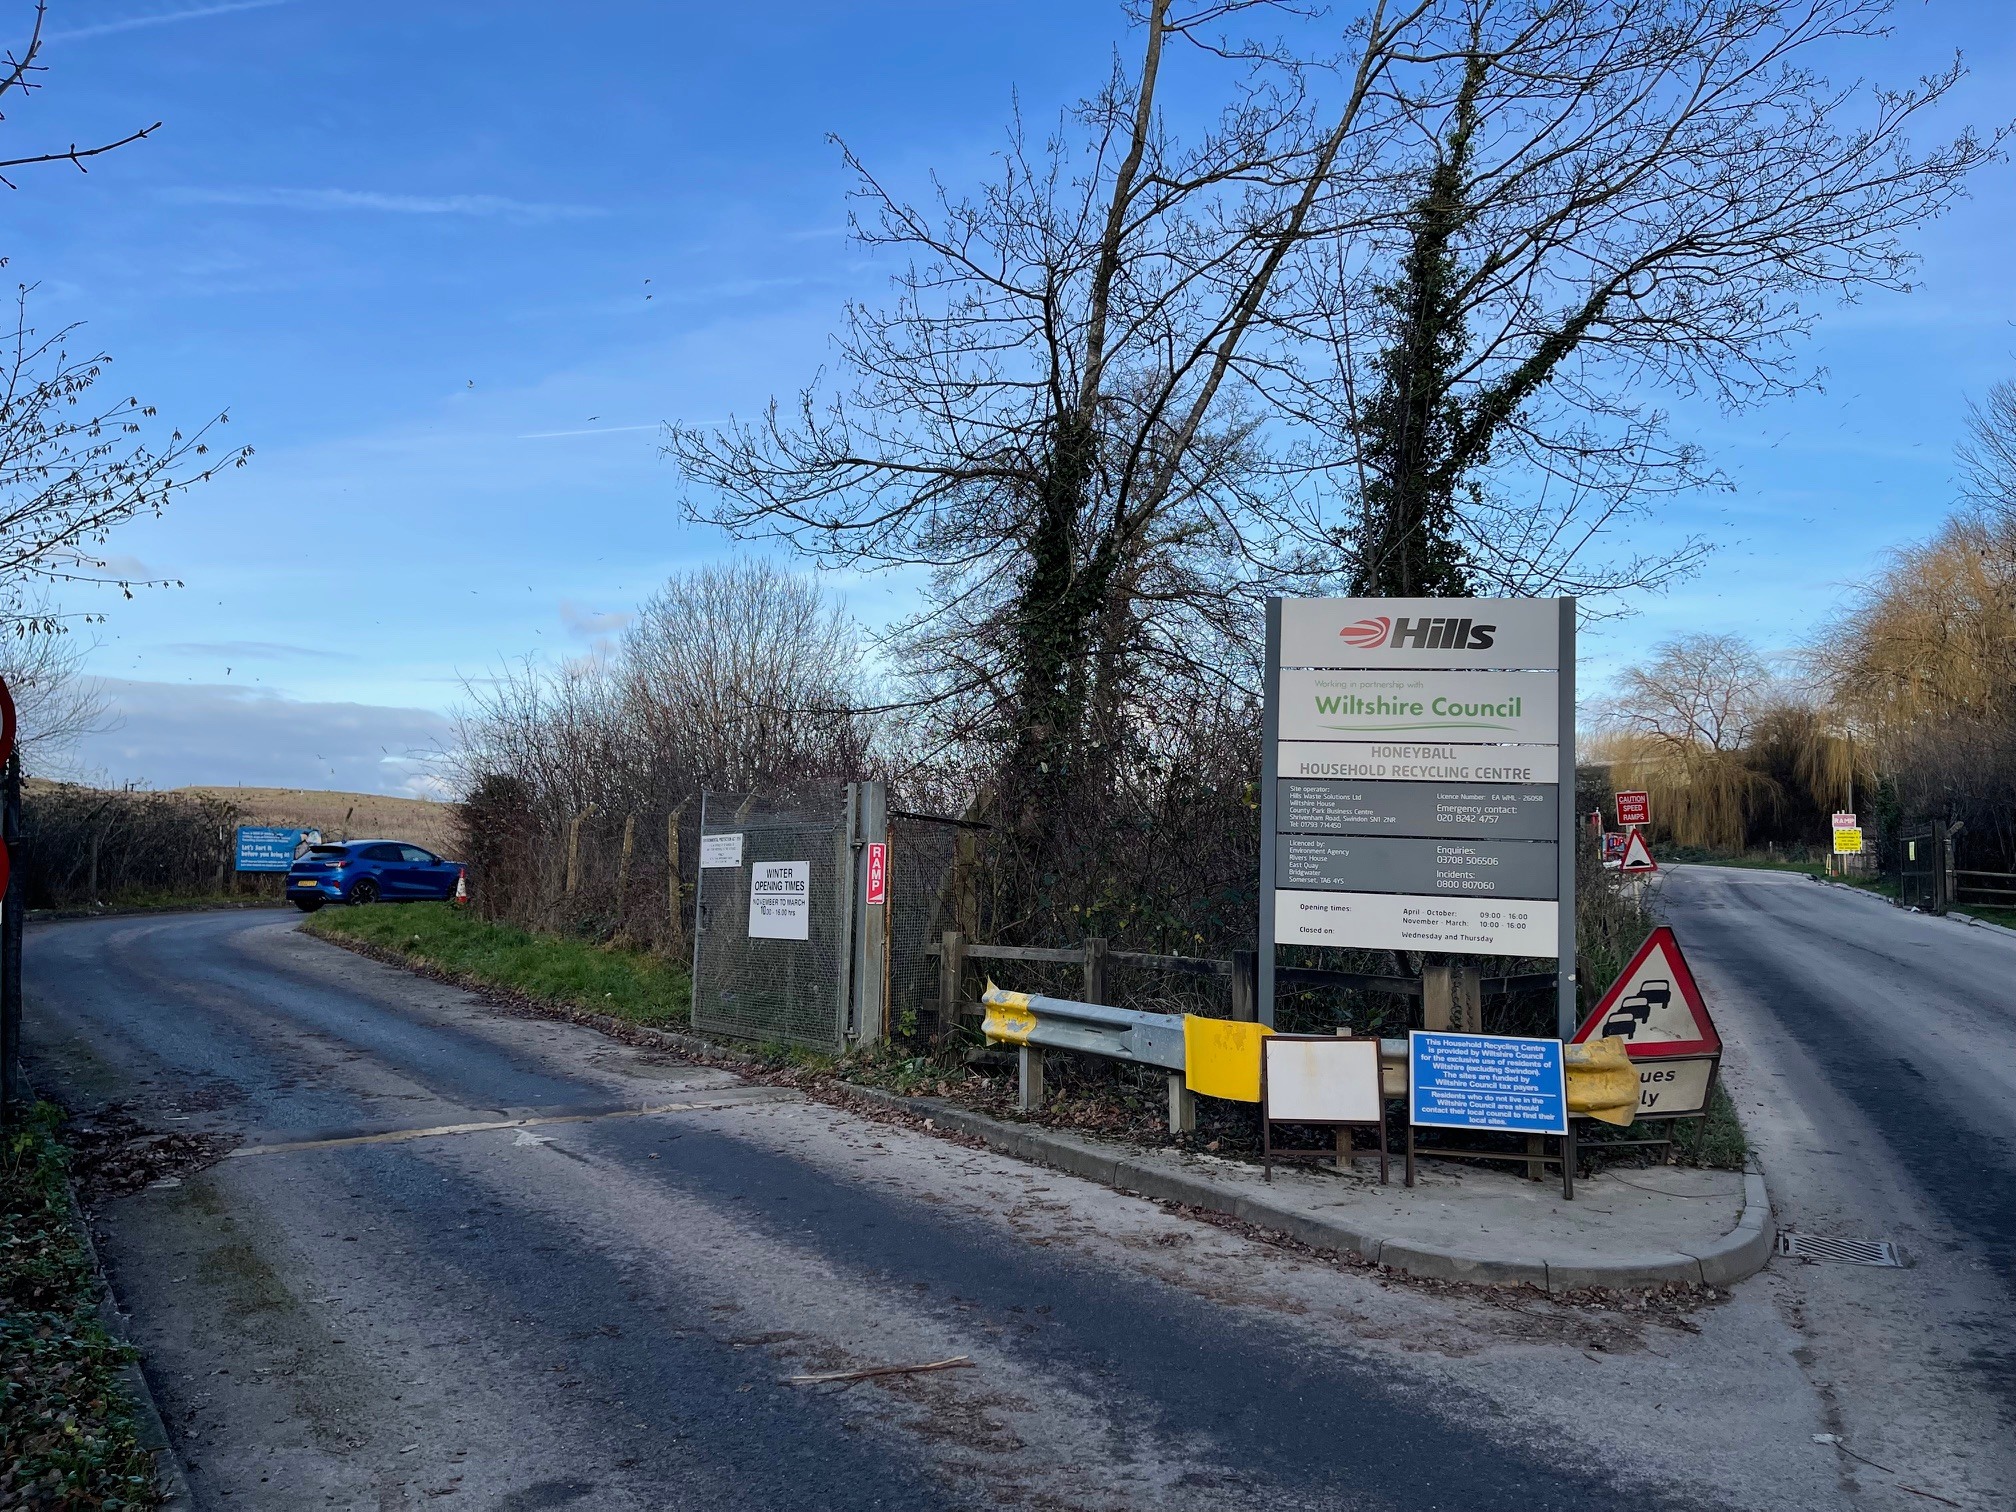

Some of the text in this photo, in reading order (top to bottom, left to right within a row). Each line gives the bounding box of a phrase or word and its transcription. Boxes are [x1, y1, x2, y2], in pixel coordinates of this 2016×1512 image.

[1390, 617, 1496, 650] Hills
[1315, 679, 1423, 689] Working in partnership with
[1315, 695, 1521, 717] Wiltshire Council
[1371, 746, 1457, 760] HONEYBALL
[1300, 763, 1530, 780] HOUSEHOLD RECYCLING CENTRE
[1290, 807, 1310, 815] County
[1437, 804, 1517, 814] Emergency contact:
[1437, 814, 1499, 823] 020 8242 4757
[1317, 840, 1325, 848] by:
[1289, 847, 1326, 855] Environment
[1437, 845, 1476, 855] Enquiries:
[1437, 856, 1499, 866] 03708 506506
[767, 869, 792, 878] WINTER
[872, 846, 881, 891] RAMP
[1437, 870, 1475, 879] Incidents:
[755, 881, 804, 891] OPENING TIMES
[1437, 880, 1495, 890] 0800 807060
[1300, 903, 1328, 912] Opening
[1403, 908, 1420, 916] April
[1299, 926, 1322, 934] Closed
[1507, 922, 1526, 930] 16:00
[1401, 932, 1442, 941] Wednesday
[1460, 934, 1494, 943] Thursday
[1443, 1040, 1481, 1049] Household
[1483, 1042, 1519, 1051] Recycling
[1521, 1044, 1546, 1052] Centre
[1436, 1048, 1468, 1056] provided
[1470, 1049, 1480, 1057] by
[1481, 1050, 1514, 1059] Wiltshire
[1446, 1056, 1480, 1064] exclusive
[1497, 1058, 1506, 1066] of
[1506, 1060, 1541, 1069] residents
[1543, 1061, 1552, 1069] of
[1432, 1062, 1540, 1077] Wiltshire (excluding Swindon).
[1443, 1071, 1457, 1079] The
[1458, 1072, 1476, 1080] sites
[1492, 1074, 1518, 1083] funded
[1520, 1075, 1530, 1084] by
[1640, 1070, 1675, 1083] ues
[1435, 1079, 1467, 1087] Wiltshire
[1469, 1081, 1497, 1089] Council
[1513, 1084, 1539, 1092] payers
[1431, 1091, 1465, 1100] Residents
[1467, 1093, 1482, 1101] who
[1495, 1095, 1508, 1103] not
[1437, 1099, 1468, 1107] Wiltshire
[1469, 1101, 1496, 1109] Council
[1514, 1103, 1539, 1111] should
[1421, 1106, 1448, 1114] contact
[1449, 1107, 1465, 1115] their
[1467, 1108, 1484, 1116] local
[1485, 1110, 1511, 1118] council
[1469, 1116, 1507, 1125] local sites.
